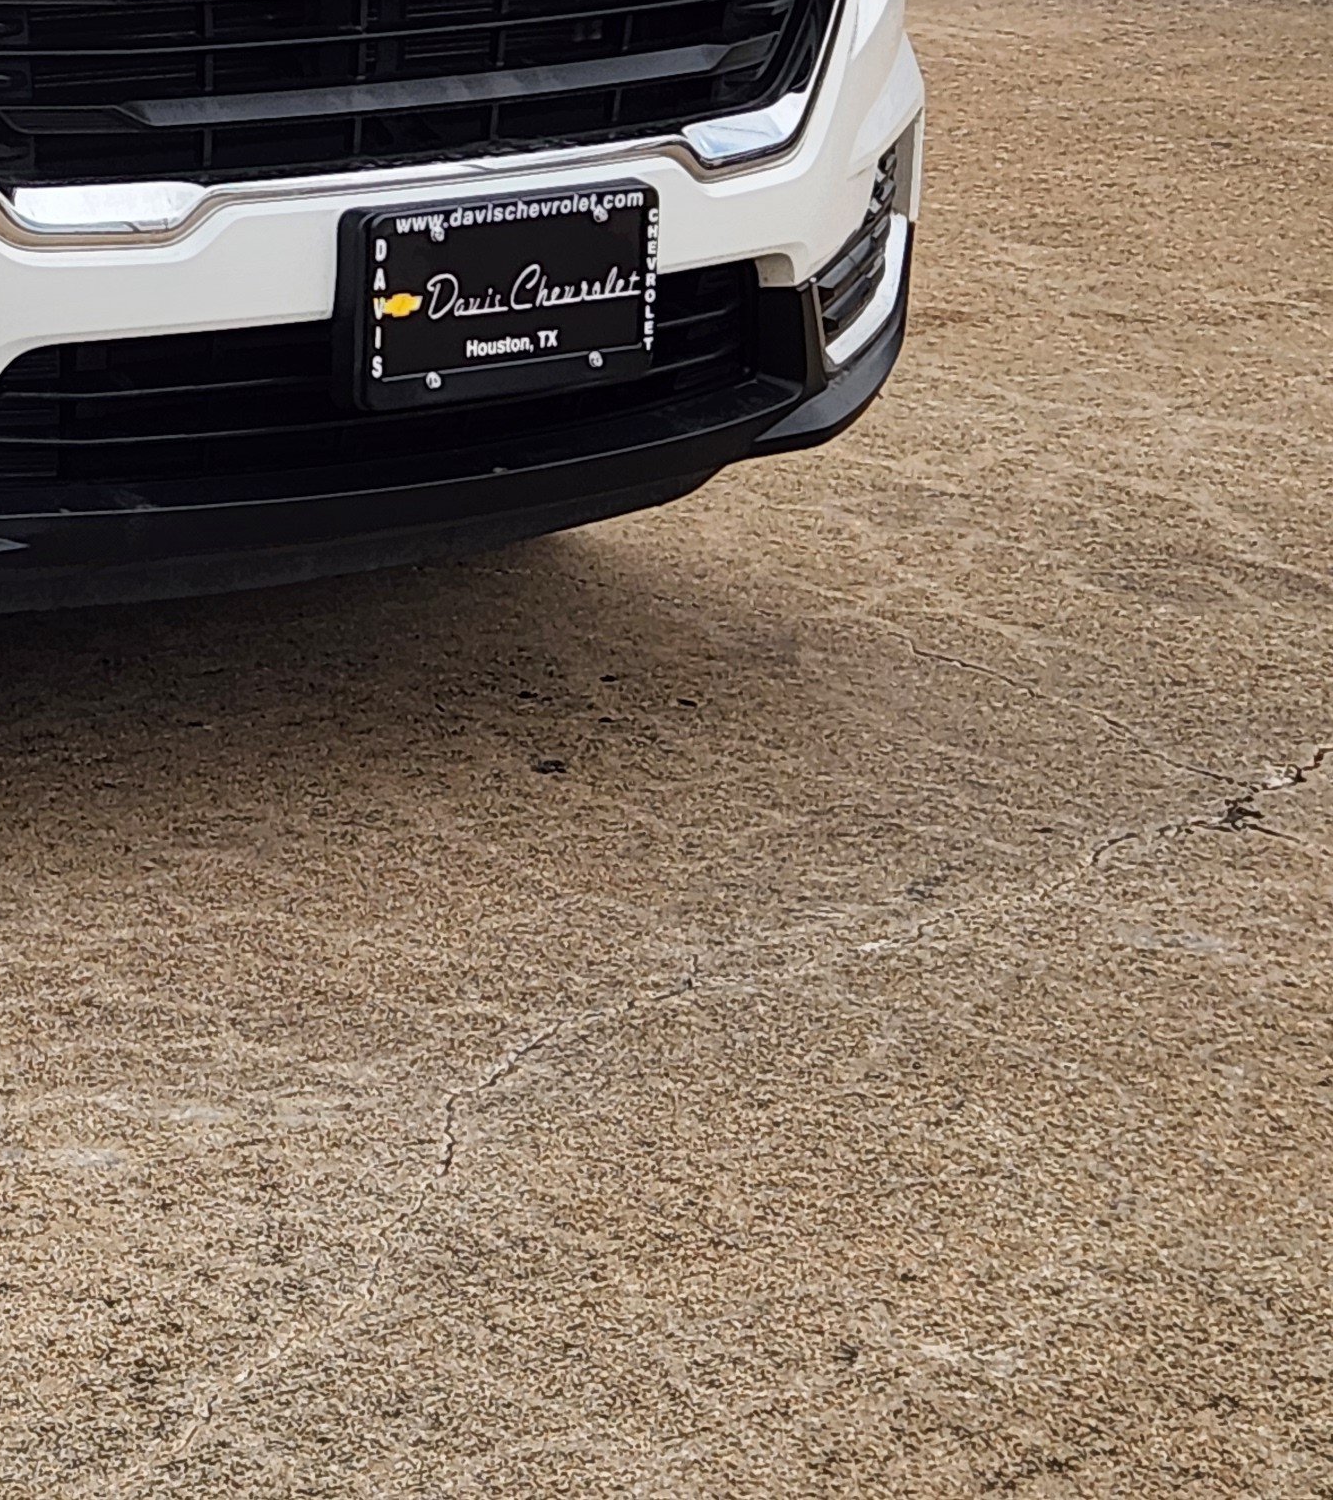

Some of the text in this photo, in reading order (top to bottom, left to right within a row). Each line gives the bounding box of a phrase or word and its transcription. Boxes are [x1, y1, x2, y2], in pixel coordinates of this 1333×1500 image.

[395, 191, 644, 234] www.davischevrolet.com
[370, 238, 388, 379] DAVIS
[425, 262, 642, 321] Davis Chevrolet
[643, 207, 660, 352] CHEVROLET
[465, 330, 559, 358] Houston, TX
